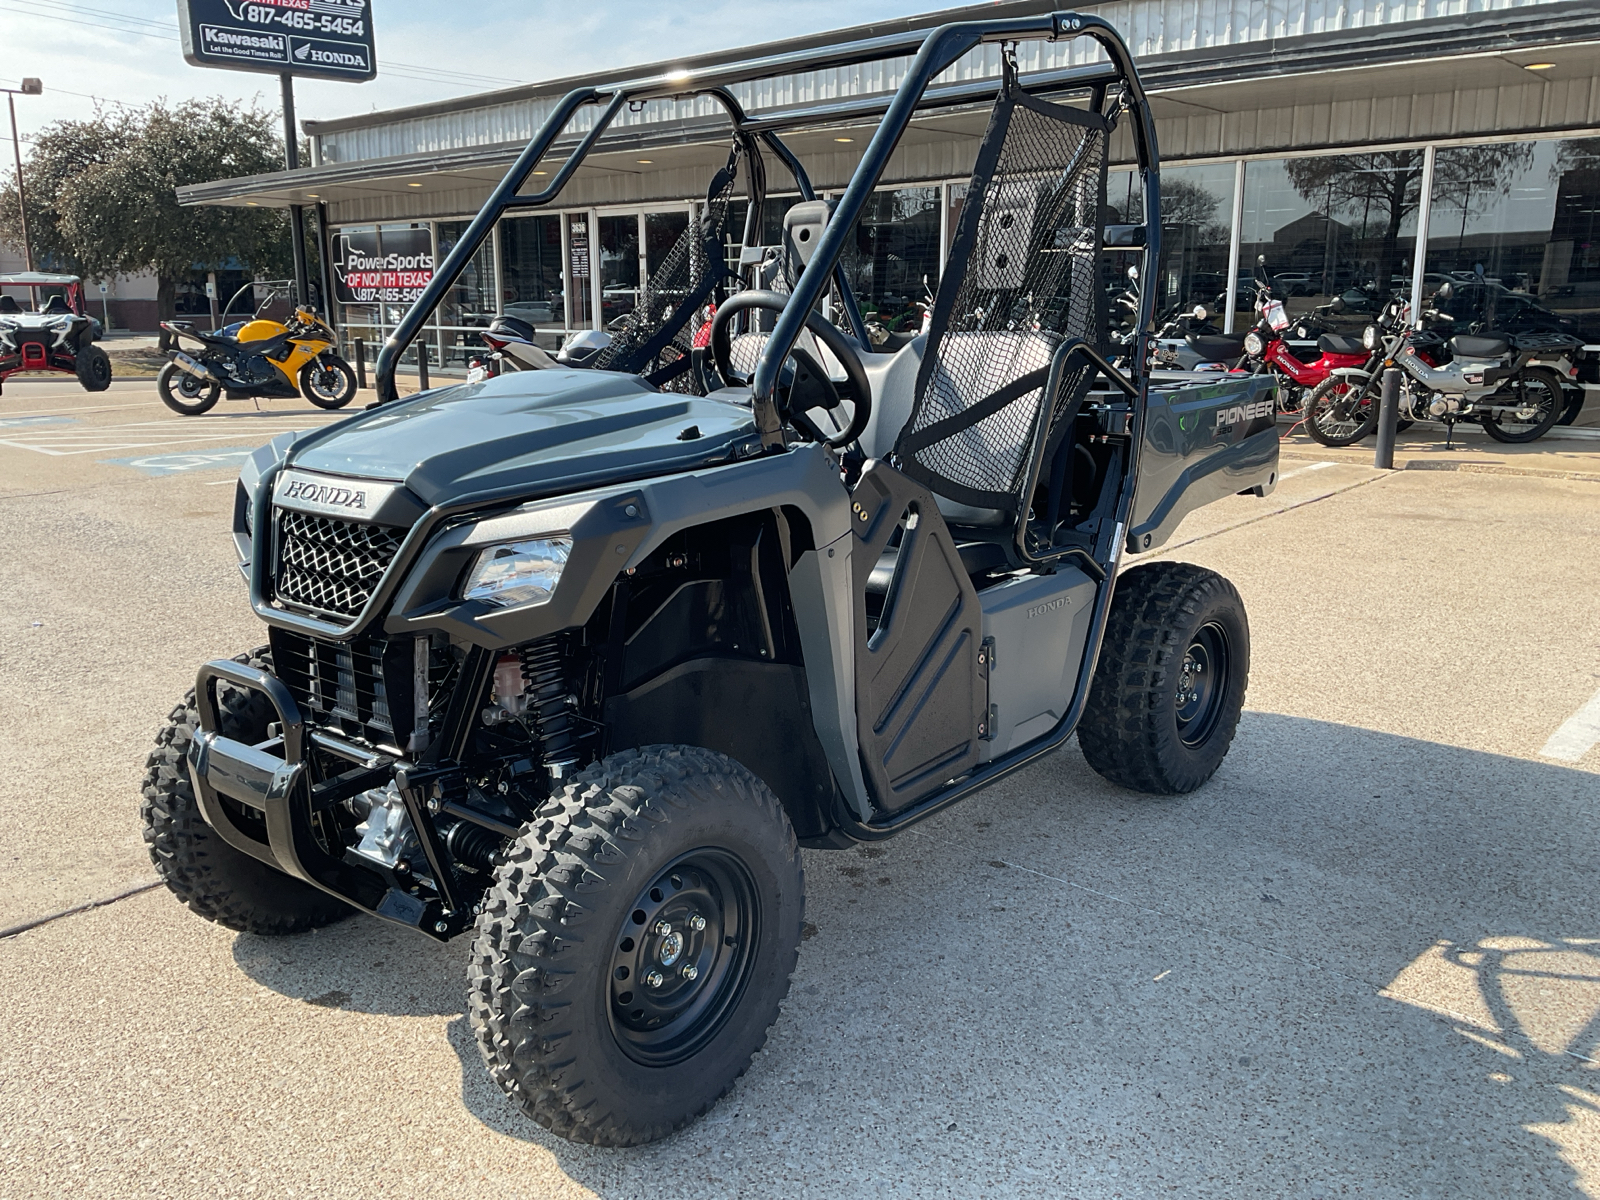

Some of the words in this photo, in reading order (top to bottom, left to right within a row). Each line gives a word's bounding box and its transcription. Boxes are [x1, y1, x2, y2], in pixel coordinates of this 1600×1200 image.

[247, 5, 364, 36] 817-465-5454
[204, 28, 284, 50] Kawasaki
[233, 47, 250, 55] Good
[250, 49, 269, 57] Times
[310, 50, 366, 66] HONDA
[348, 252, 433, 271] PowerSports
[347, 273, 361, 286] OF
[397, 272, 431, 286] TEXAS
[360, 288, 424, 301] 817-65-545
[1277, 355, 1299, 376] HONDA
[1404, 358, 1429, 379] HONDA
[1216, 400, 1274, 427] PIONEER
[284, 481, 367, 509] HONDA
[1026, 595, 1073, 619] HONDA
